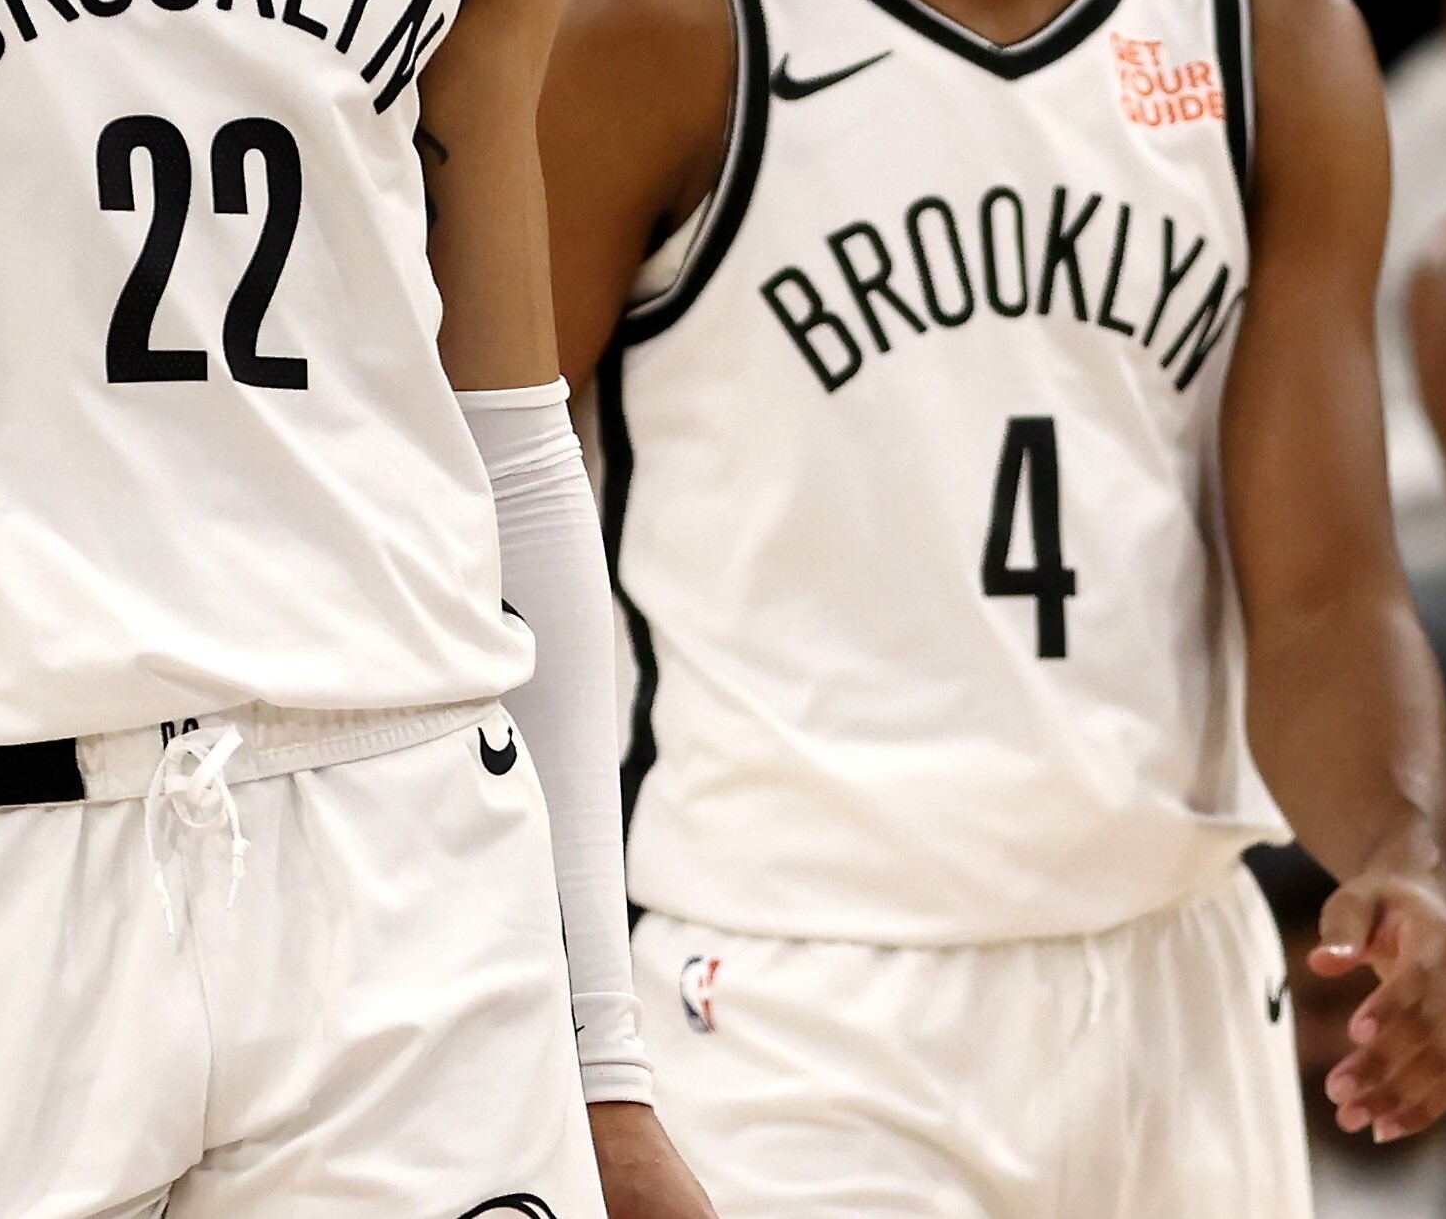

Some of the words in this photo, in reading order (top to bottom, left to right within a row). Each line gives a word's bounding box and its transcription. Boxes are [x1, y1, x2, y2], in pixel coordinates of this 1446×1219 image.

[97, 115, 308, 390] 22
[761, 187, 1247, 393] BROOKLYN
[982, 417, 1076, 659] 4
